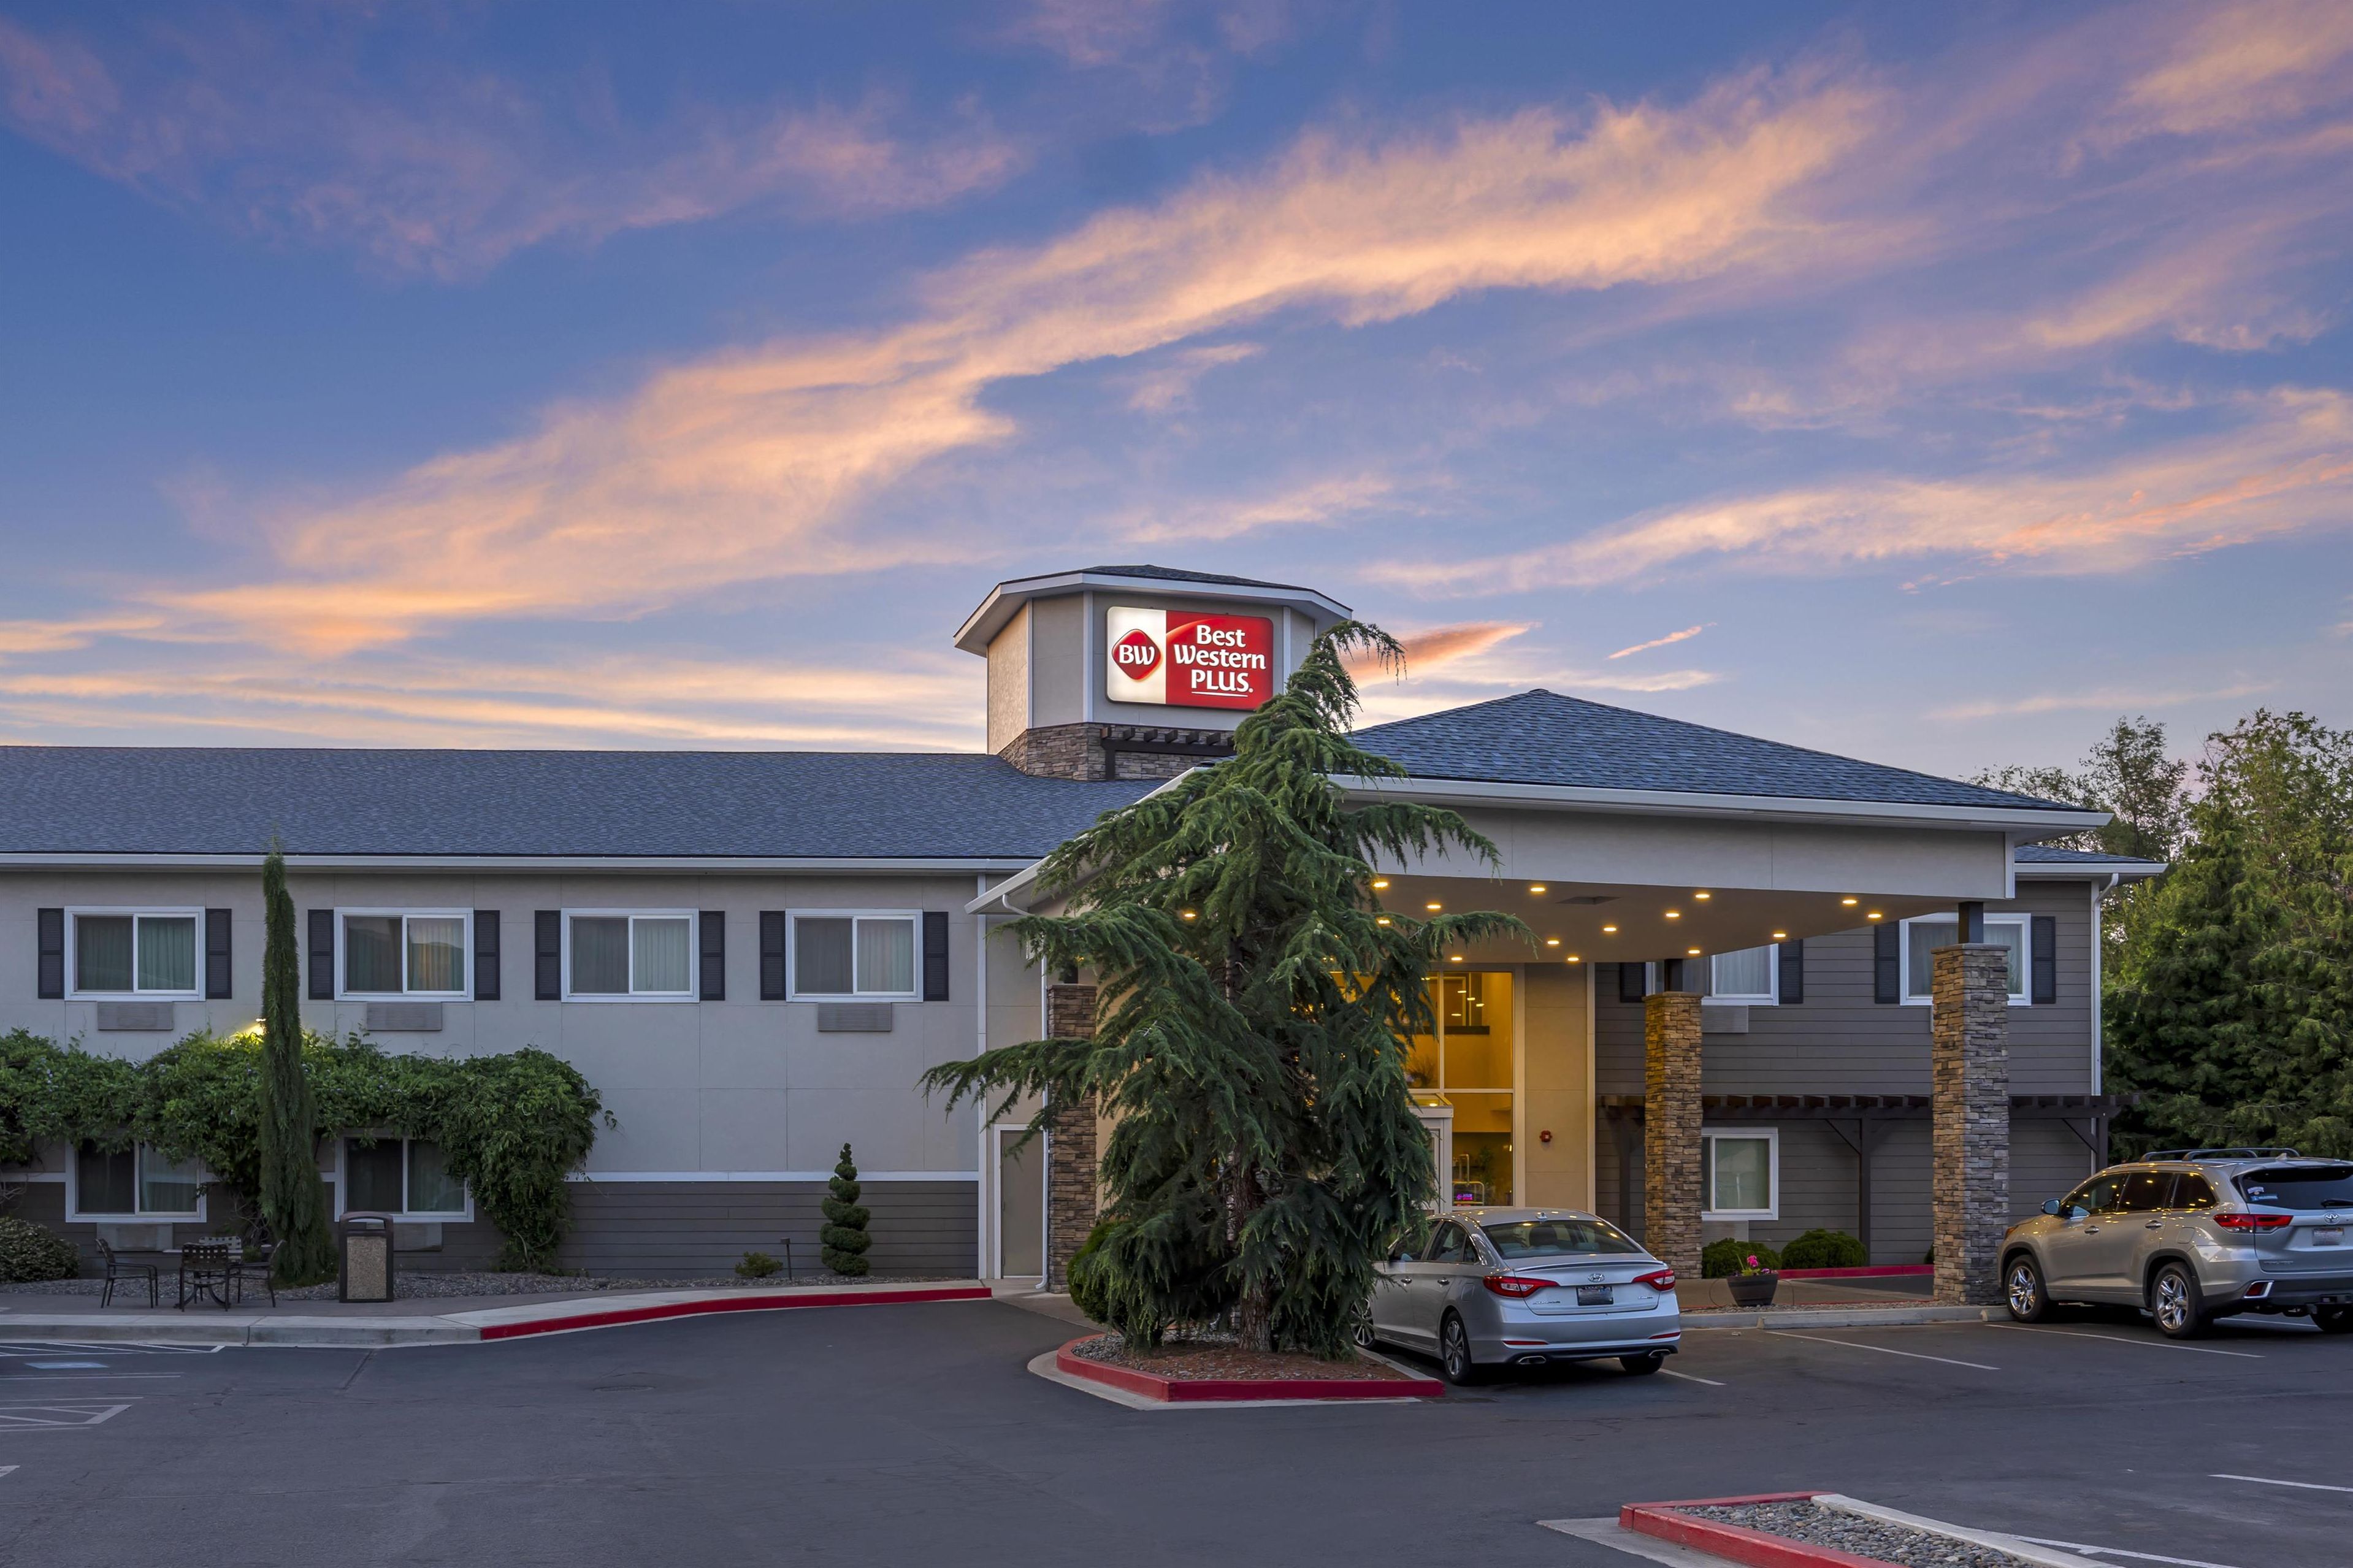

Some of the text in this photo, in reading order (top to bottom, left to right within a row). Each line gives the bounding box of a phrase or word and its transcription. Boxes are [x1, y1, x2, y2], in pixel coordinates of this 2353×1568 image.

[1196, 624, 1246, 648] Best
[1119, 644, 1155, 665] BW
[1173, 644, 1266, 670] Western
